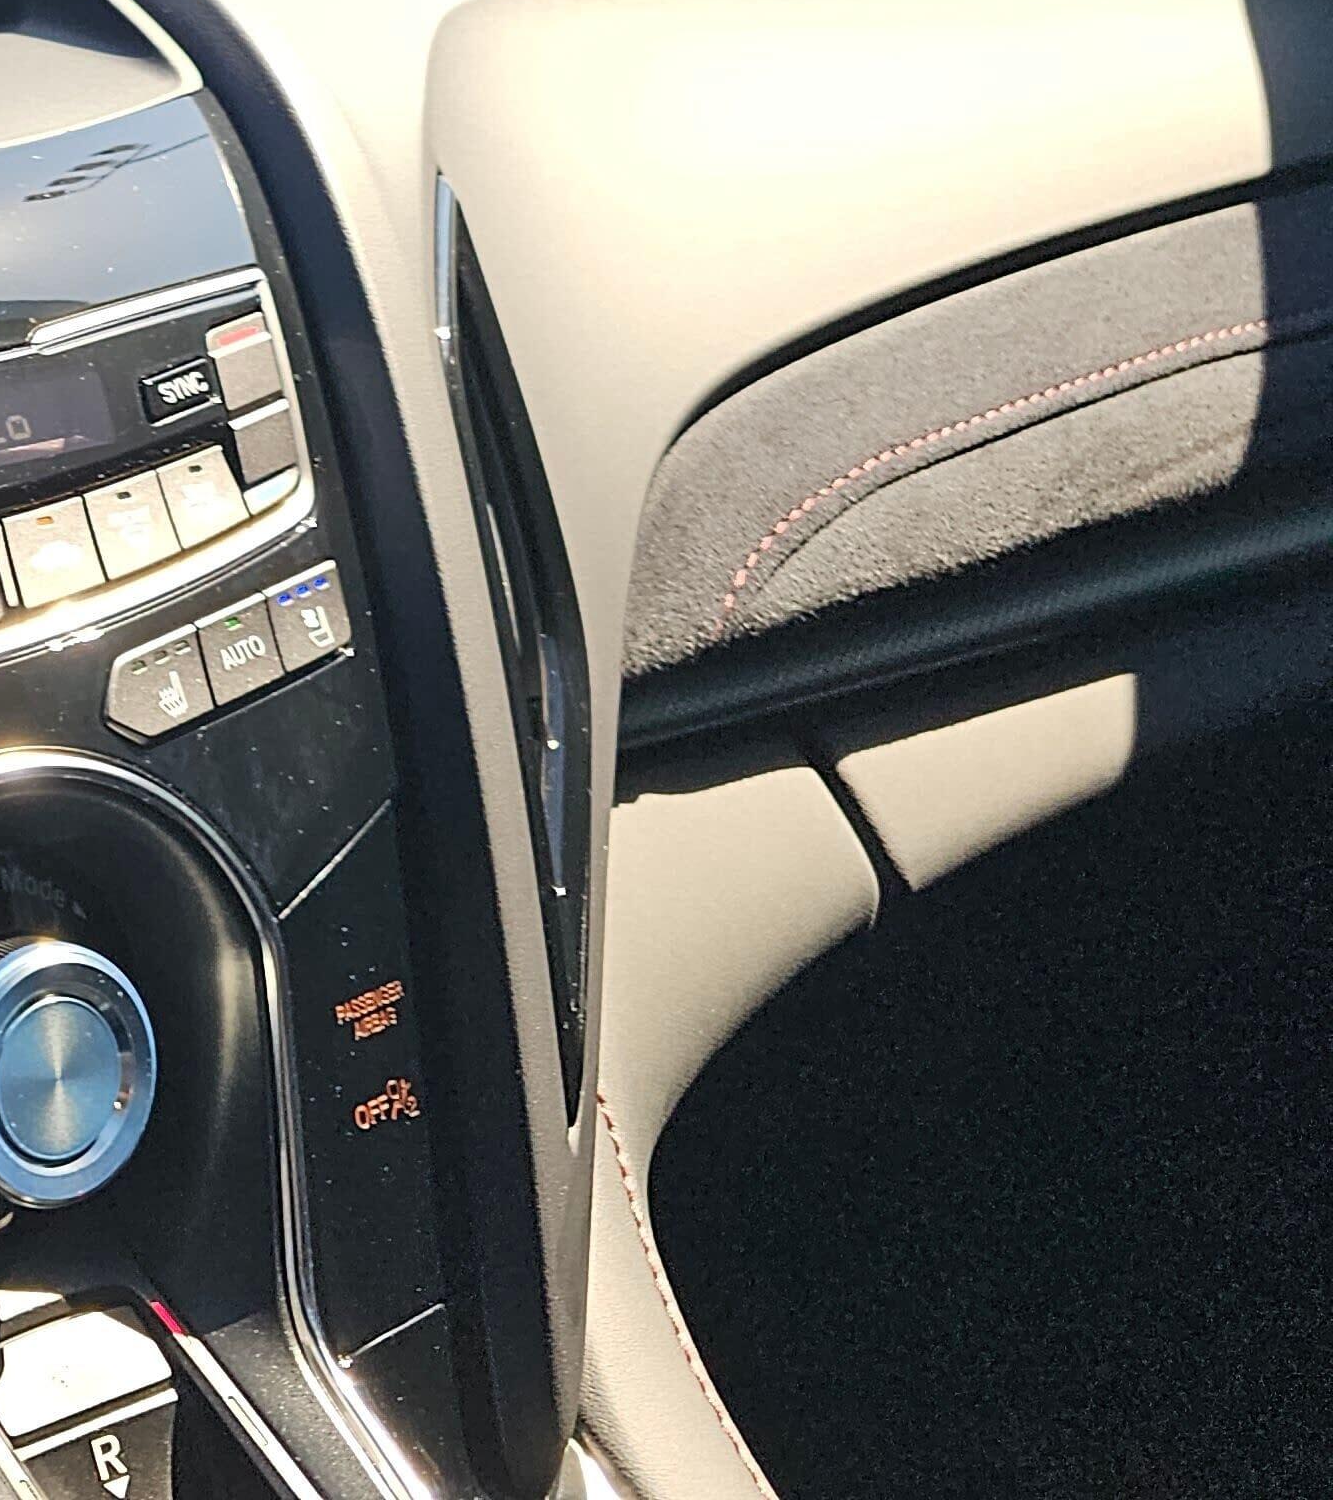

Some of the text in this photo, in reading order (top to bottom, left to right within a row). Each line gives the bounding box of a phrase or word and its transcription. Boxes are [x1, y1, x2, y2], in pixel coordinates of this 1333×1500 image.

[157, 371, 210, 404] SYNC
[220, 634, 266, 671] AUTO
[354, 1094, 390, 1130] OFF
[90, 1434, 128, 1481] R
